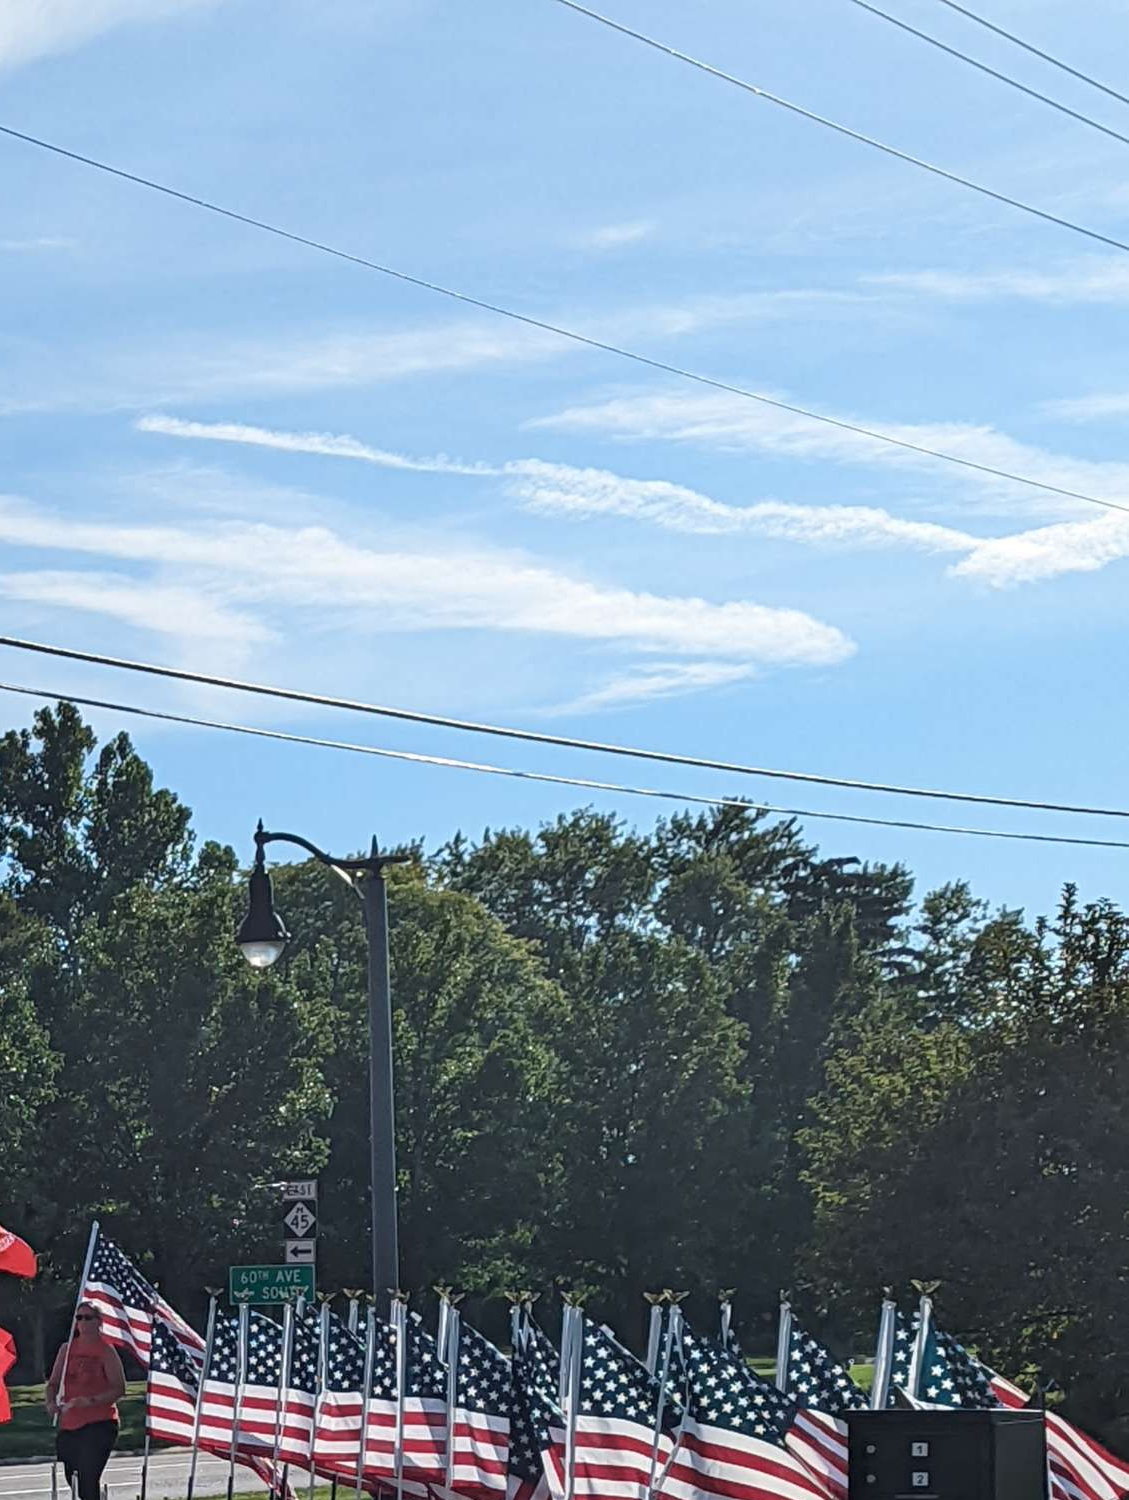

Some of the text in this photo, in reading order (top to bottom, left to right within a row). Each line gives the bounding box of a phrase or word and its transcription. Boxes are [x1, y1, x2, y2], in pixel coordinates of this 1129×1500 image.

[290, 1214, 310, 1229] 45
[240, 1269, 301, 1284] 60TH AVE
[917, 1474, 924, 1484] 2
